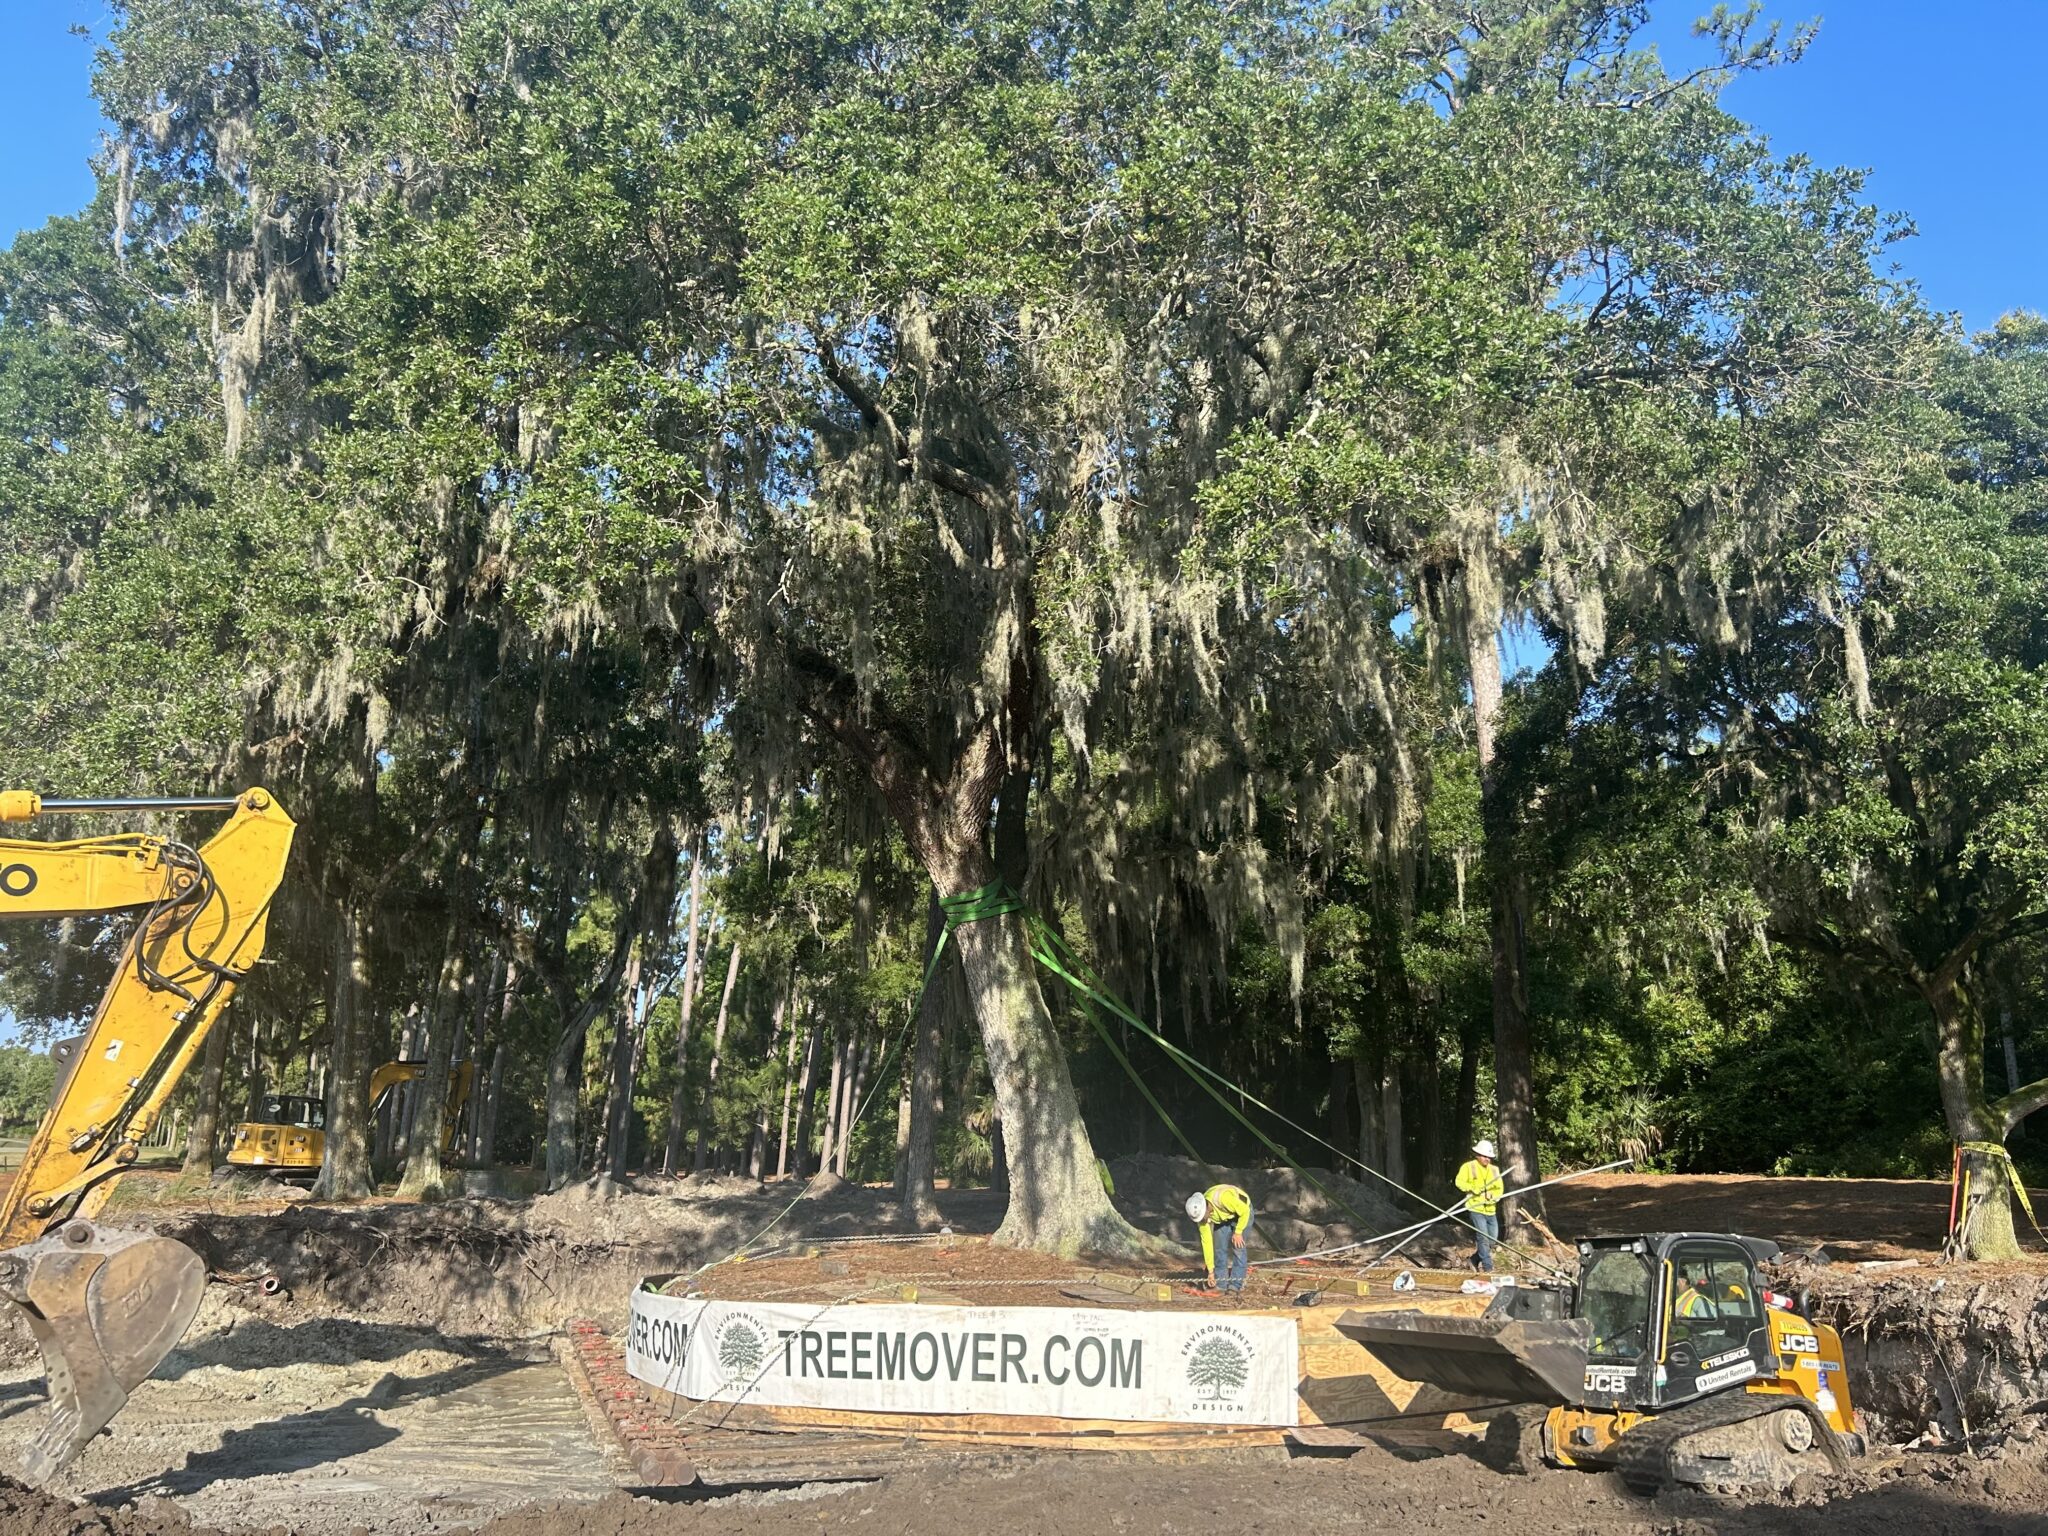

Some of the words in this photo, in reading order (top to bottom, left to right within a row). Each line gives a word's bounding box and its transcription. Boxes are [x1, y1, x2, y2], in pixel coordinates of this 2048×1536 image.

[0, 863, 38, 897] O
[714, 1311, 769, 1343] ENVIRONMENTAL
[1181, 1325, 1256, 1359] ENVIRONMENTAL
[1780, 1334, 1819, 1353] JCB
[777, 1330, 1142, 1389] TREEMOVER.COM
[1709, 1347, 1750, 1368] TELESKID
[1584, 1374, 1627, 1393] JCB
[1707, 1371, 1729, 1385] United
[1729, 1365, 1752, 1378] Rentals
[1192, 1403, 1244, 1412] DESIGN
